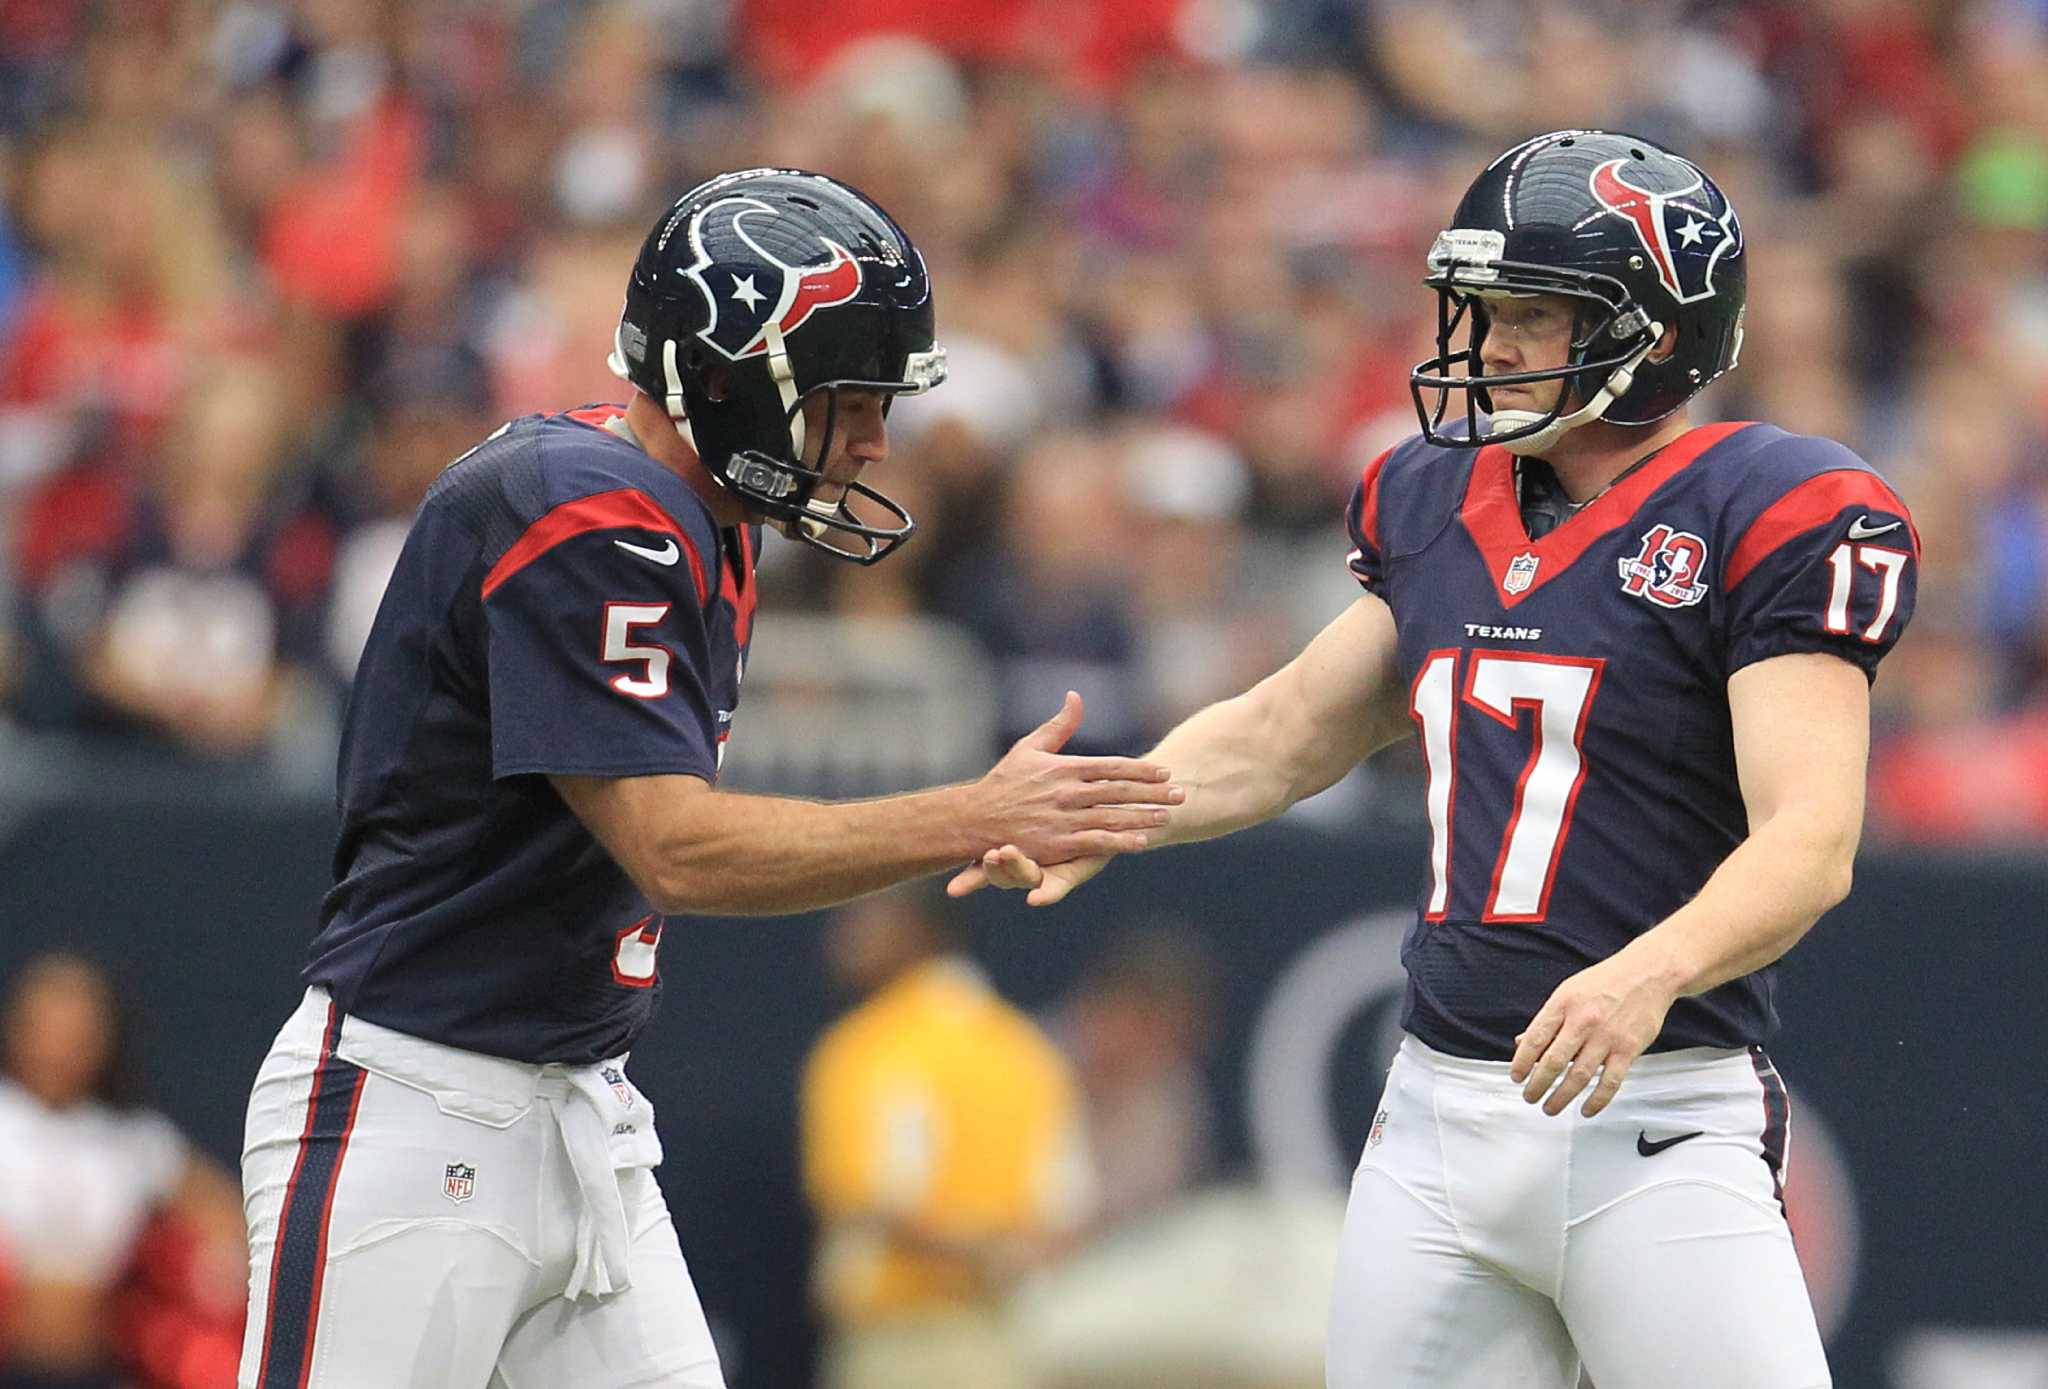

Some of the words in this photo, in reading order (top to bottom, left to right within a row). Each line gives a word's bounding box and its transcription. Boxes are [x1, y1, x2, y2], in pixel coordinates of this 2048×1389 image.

[1463, 623, 1543, 641] TEXANS
[1824, 543, 1912, 643] 17
[601, 602, 673, 699] 5
[1410, 647, 1606, 923] 17
[446, 1178, 472, 1196] NFL
